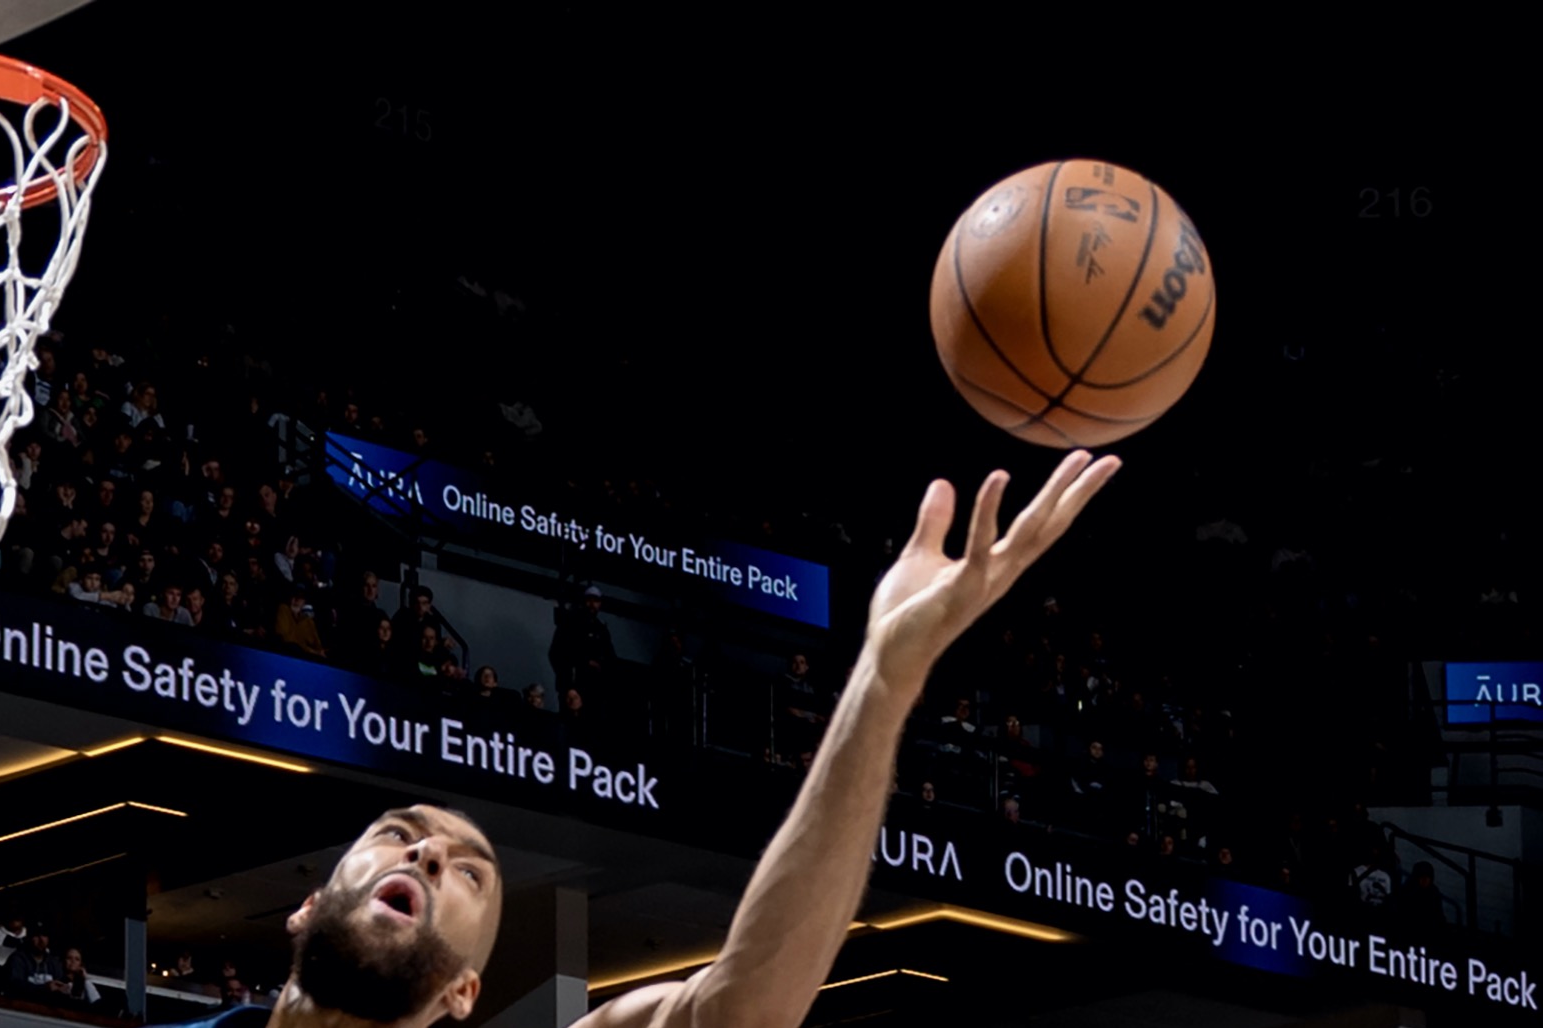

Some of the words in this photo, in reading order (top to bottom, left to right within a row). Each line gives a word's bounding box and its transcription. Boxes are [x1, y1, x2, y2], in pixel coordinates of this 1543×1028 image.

[373, 95, 433, 144] 215
[1357, 185, 1434, 219] 216
[441, 484, 517, 527] Online
[518, 504, 590, 551] Safety
[594, 525, 626, 556] for
[627, 532, 679, 570] Your
[680, 546, 744, 588] Entire
[746, 563, 800, 603] Pack
[119, 642, 261, 727] Safety
[268, 679, 330, 733] for
[336, 692, 432, 757] Your
[438, 716, 557, 786] Entire
[566, 746, 660, 810] Pack
[875, 824, 964, 883] URA
[1003, 850, 1115, 913] Online
[1122, 877, 1231, 948] Safety
[1236, 904, 1284, 951] for
[1287, 914, 1362, 969] Your
[1367, 933, 1460, 992] Entire
[1466, 956, 1540, 1012] Pack
